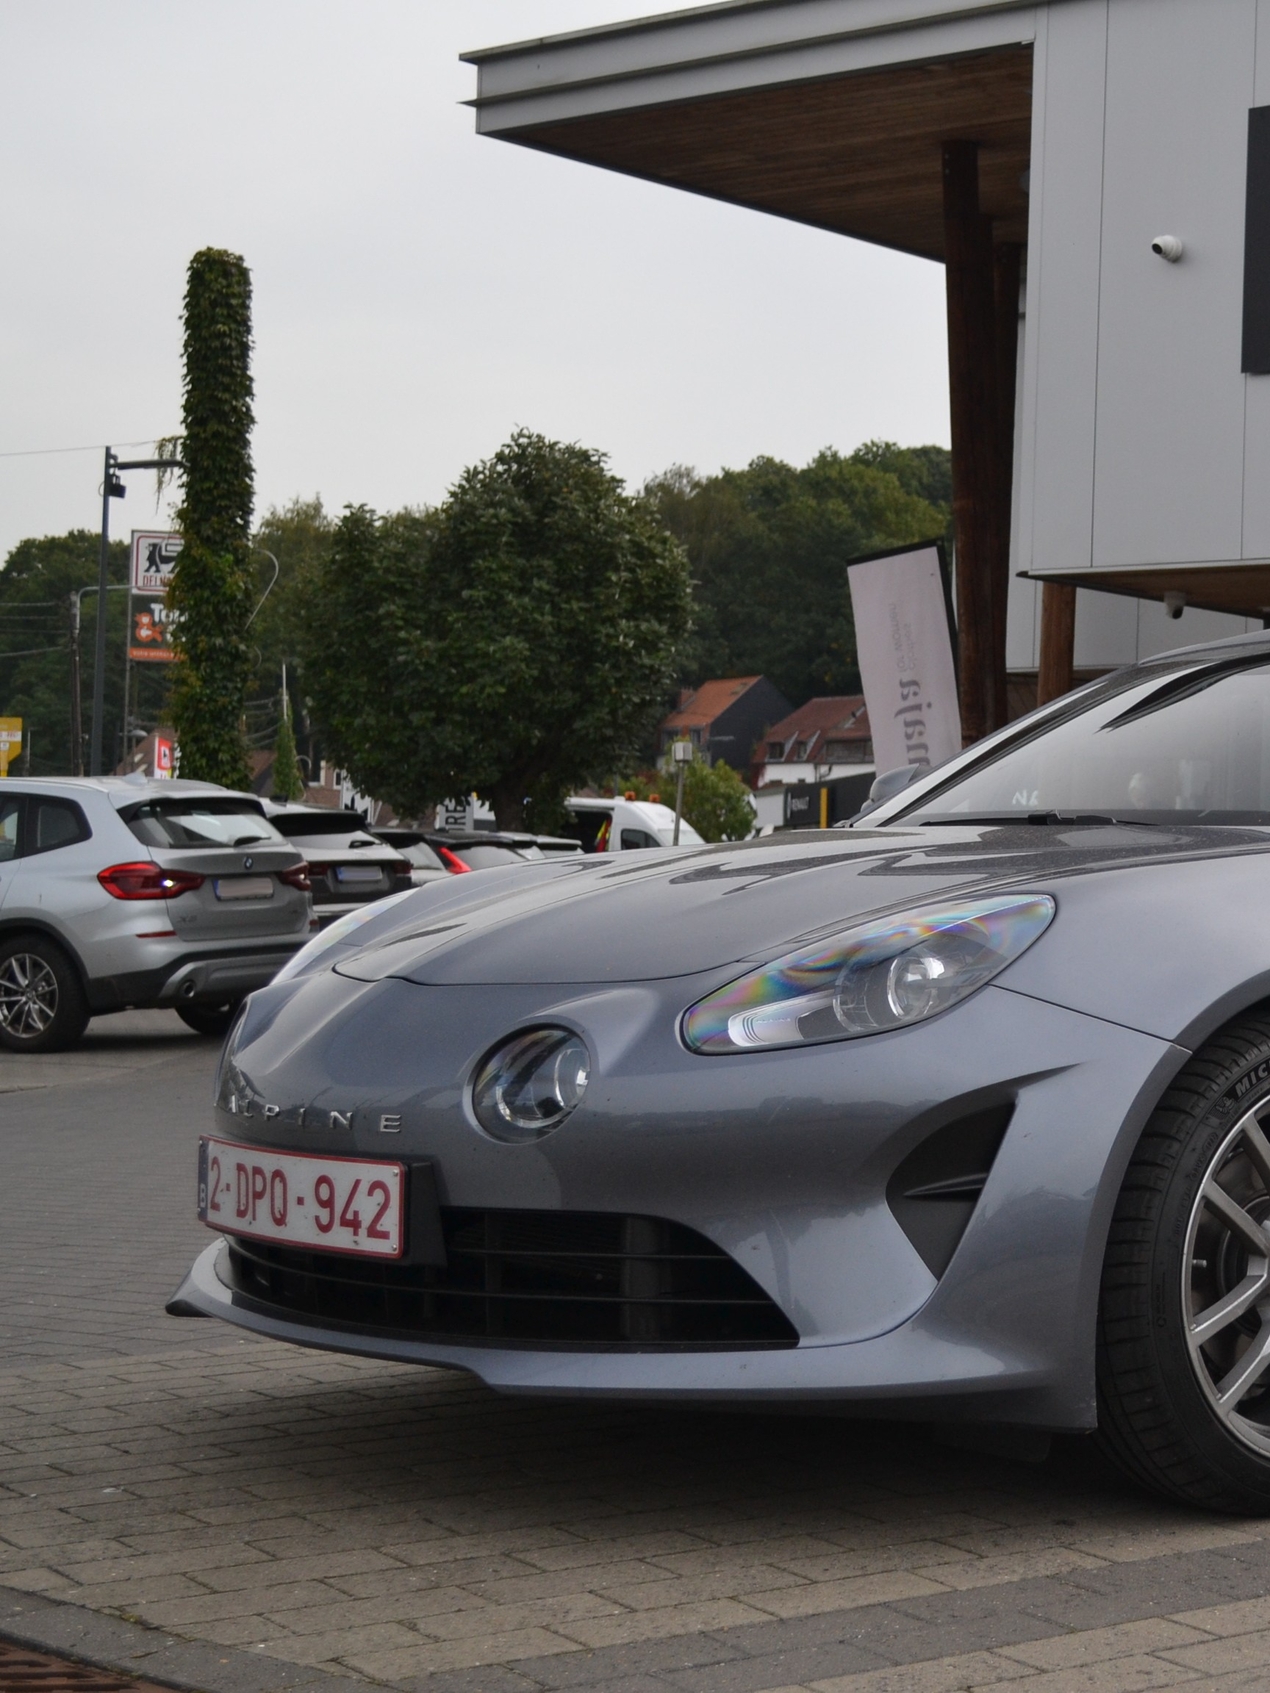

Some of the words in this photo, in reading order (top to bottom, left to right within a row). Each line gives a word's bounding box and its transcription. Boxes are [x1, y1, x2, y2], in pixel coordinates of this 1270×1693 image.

[228, 1094, 402, 1133] ALPINE
[200, 1183, 207, 1208] B
[209, 1156, 391, 1240] 2-DPQ-942
